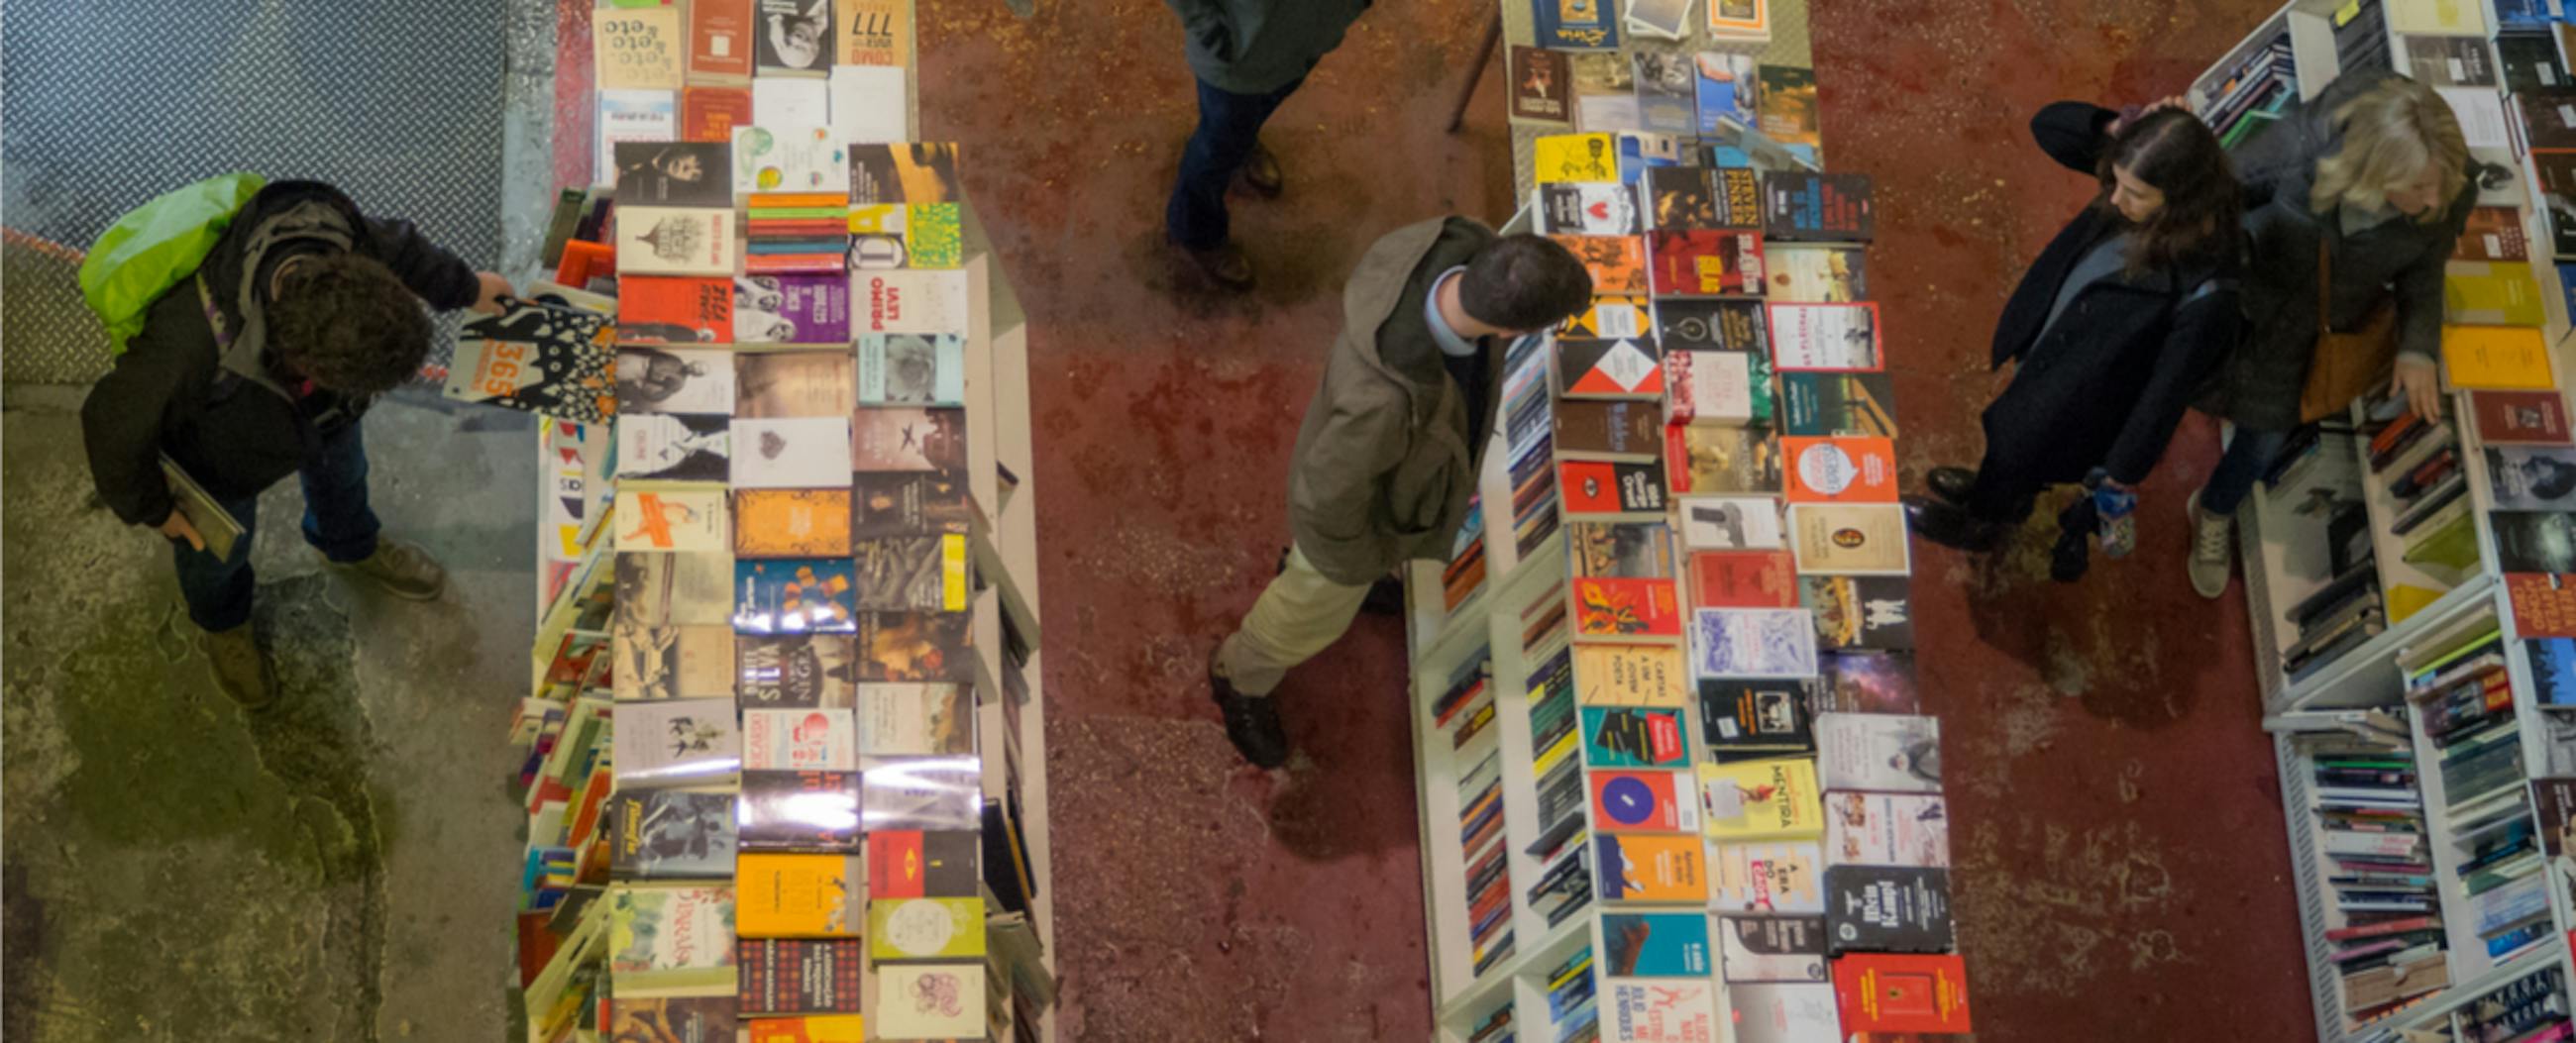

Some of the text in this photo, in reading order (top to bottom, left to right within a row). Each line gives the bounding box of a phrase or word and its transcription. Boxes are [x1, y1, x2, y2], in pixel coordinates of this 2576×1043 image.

[852, 13, 893, 37] 777
[1726, 168, 1744, 227] PINKER
[1742, 168, 1760, 226] STEVEN
[871, 276, 884, 331] PRIMO
[887, 286, 900, 321] LEVI
[485, 342, 524, 397] 365
[1623, 476, 1638, 509] Orwell
[1636, 470, 1650, 509] George
[1649, 483, 1662, 509] 1984
[2513, 585, 2525, 619] CRUZ
[2525, 578, 2543, 630] AFONSO
[758, 643, 782, 702] SILVA
[797, 645, 812, 701] NEGRA
[1613, 655, 1623, 686] POETA
[1627, 661, 1638, 694] JOVEM
[1643, 665, 1651, 681] UM
[1655, 660, 1666, 698] CARTAS
[1770, 765, 1791, 829] MENTIRA
[1764, 859, 1773, 880] DO
[1776, 868, 1789, 894] ERA
[1863, 886, 1879, 922] Mein
[1878, 881, 1899, 928] Kampf
[1615, 985, 1634, 1042] HENRIQUES
